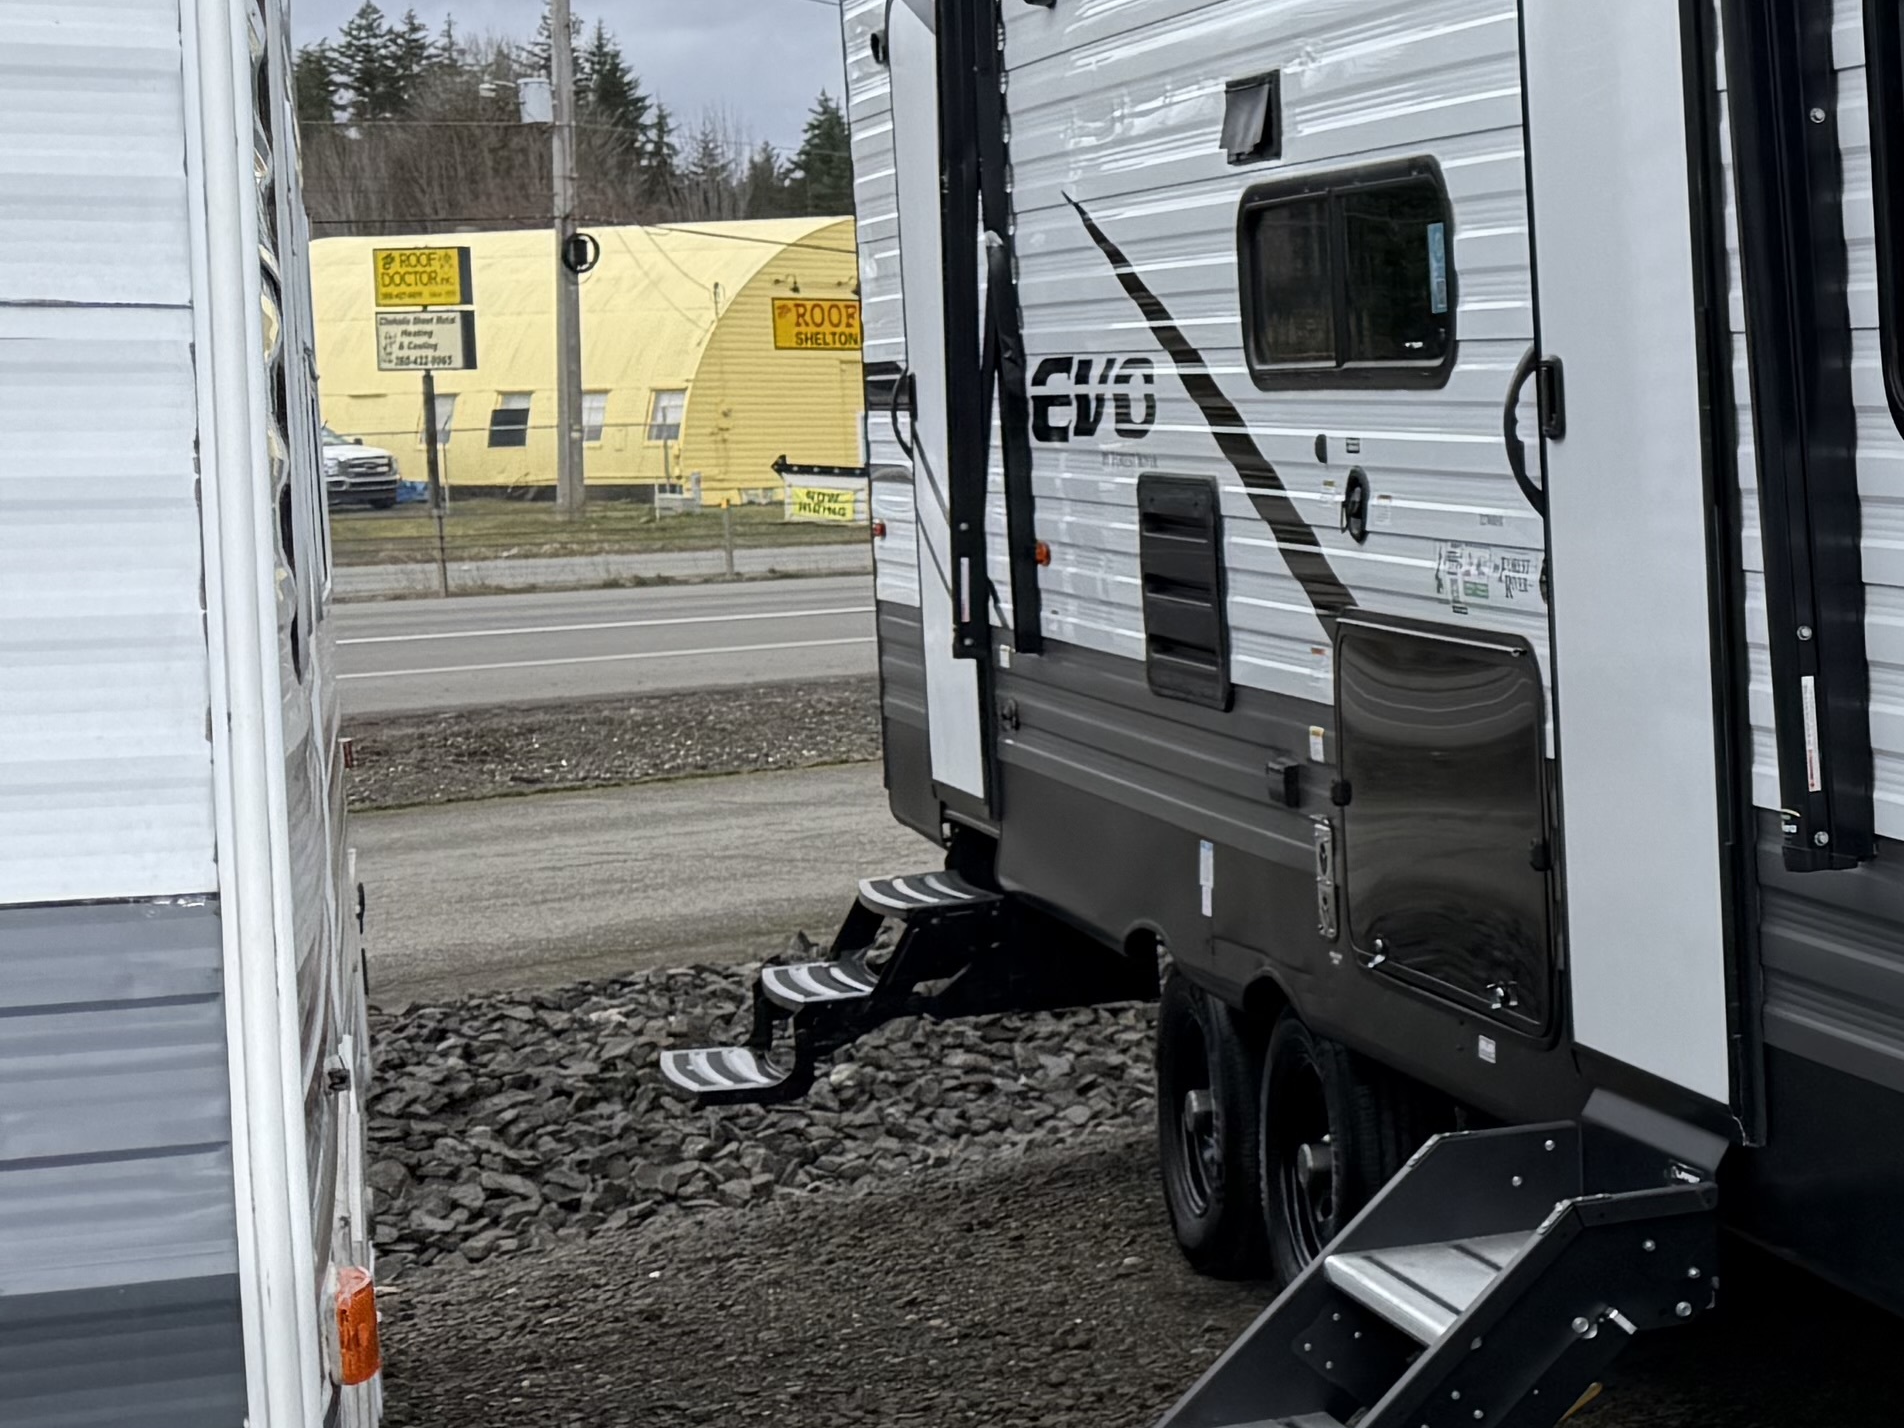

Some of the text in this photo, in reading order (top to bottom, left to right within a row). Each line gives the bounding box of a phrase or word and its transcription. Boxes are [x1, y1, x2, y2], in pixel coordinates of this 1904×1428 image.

[399, 252, 436, 268] ROOF
[381, 271, 438, 287] DOCTOR
[793, 303, 857, 328] ROOF
[795, 331, 859, 346] SHELTON
[1031, 356, 1156, 442] EVO
